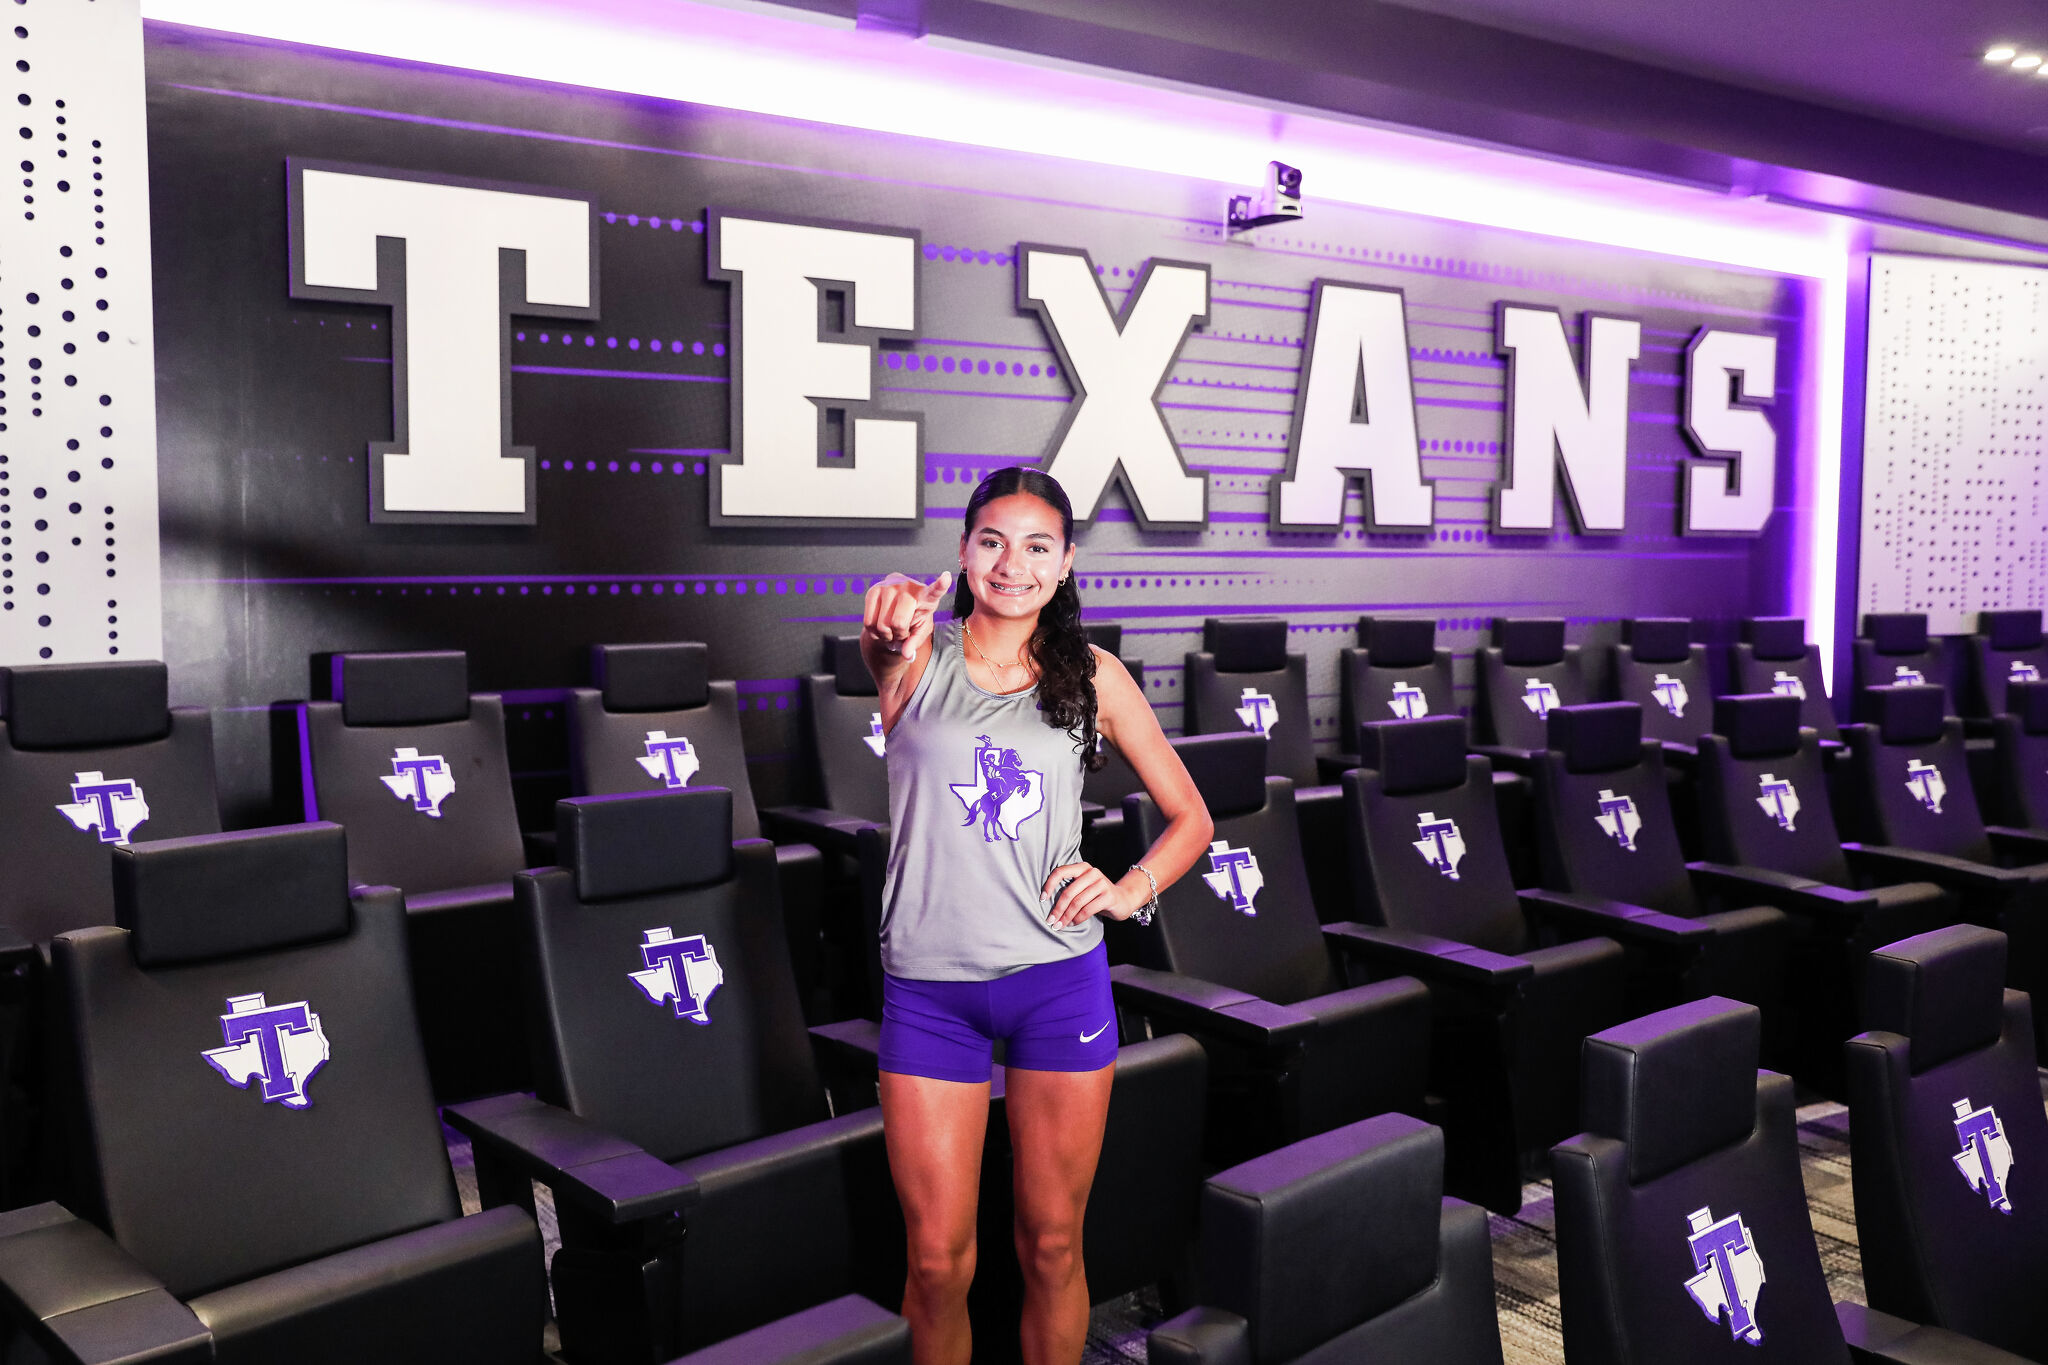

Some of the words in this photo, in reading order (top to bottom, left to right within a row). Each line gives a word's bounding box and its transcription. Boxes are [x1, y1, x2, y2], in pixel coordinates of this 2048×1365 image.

[298, 165, 1778, 536] TEXANS
[1241, 695, 1271, 734] T
[391, 756, 444, 810] T
[644, 738, 688, 788] T
[1908, 766, 1938, 809] T
[71, 780, 136, 842] T
[1599, 796, 1632, 846] T
[1760, 780, 1790, 826] T
[1418, 820, 1456, 874] T
[1209, 848, 1252, 910] T
[640, 934, 710, 1018] T
[221, 1000, 314, 1103] T
[1954, 1106, 2006, 1207] T
[1688, 1212, 1755, 1340] T
